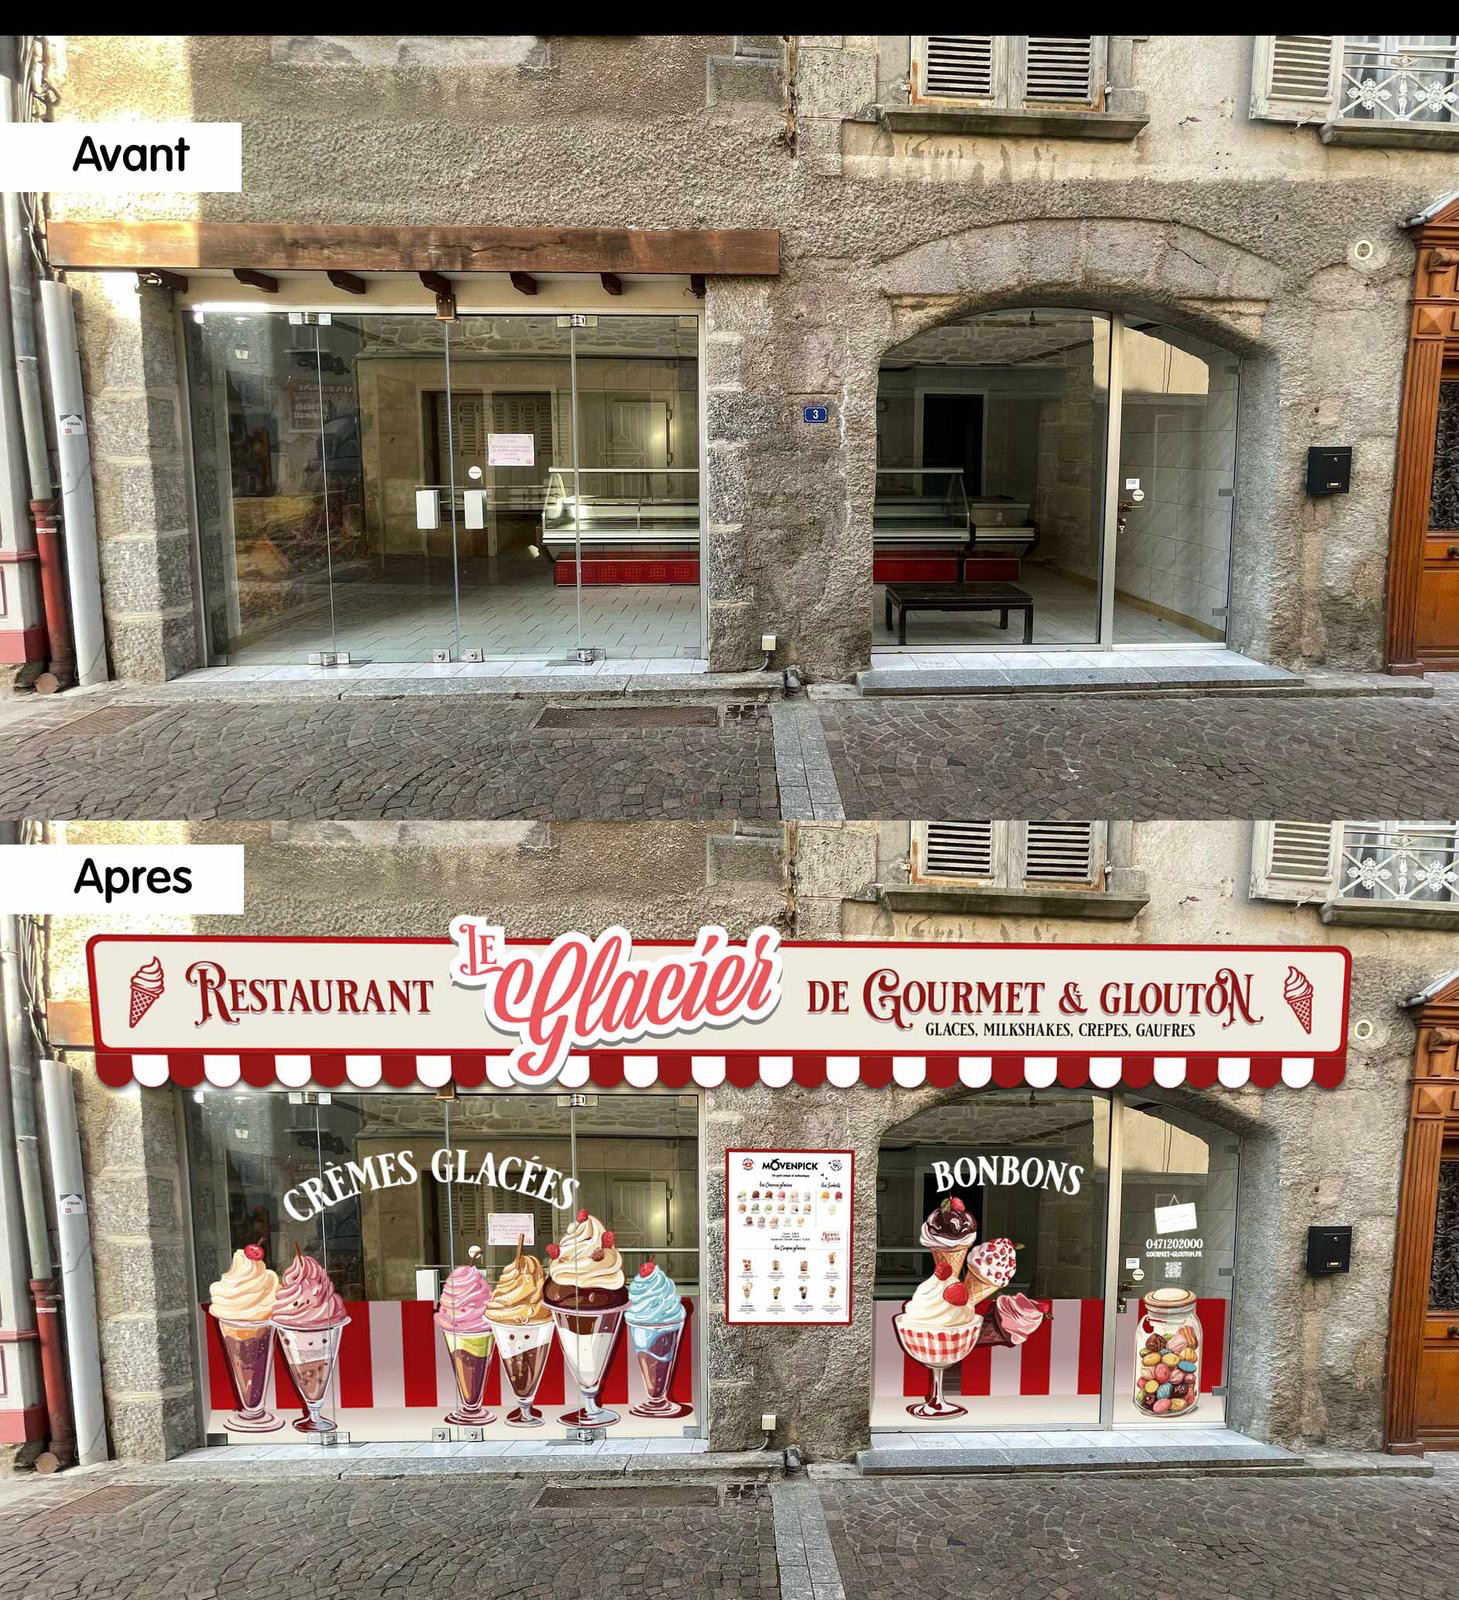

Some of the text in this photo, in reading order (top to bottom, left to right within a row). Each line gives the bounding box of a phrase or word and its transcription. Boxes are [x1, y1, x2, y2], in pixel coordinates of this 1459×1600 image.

[812, 409, 819, 420] 3
[459, 924, 504, 976] LE
[806, 967, 1264, 1030] DE GOURMET & GLOUTON
[925, 1022, 1196, 1038] GLACES, MILKSHAKES, CREPES, GAUFRES
[283, 1149, 580, 1222] CRÈMES GLACÉES
[931, 1155, 1085, 1196] BONBONS
[1146, 1238, 1204, 1250] 0471202000
